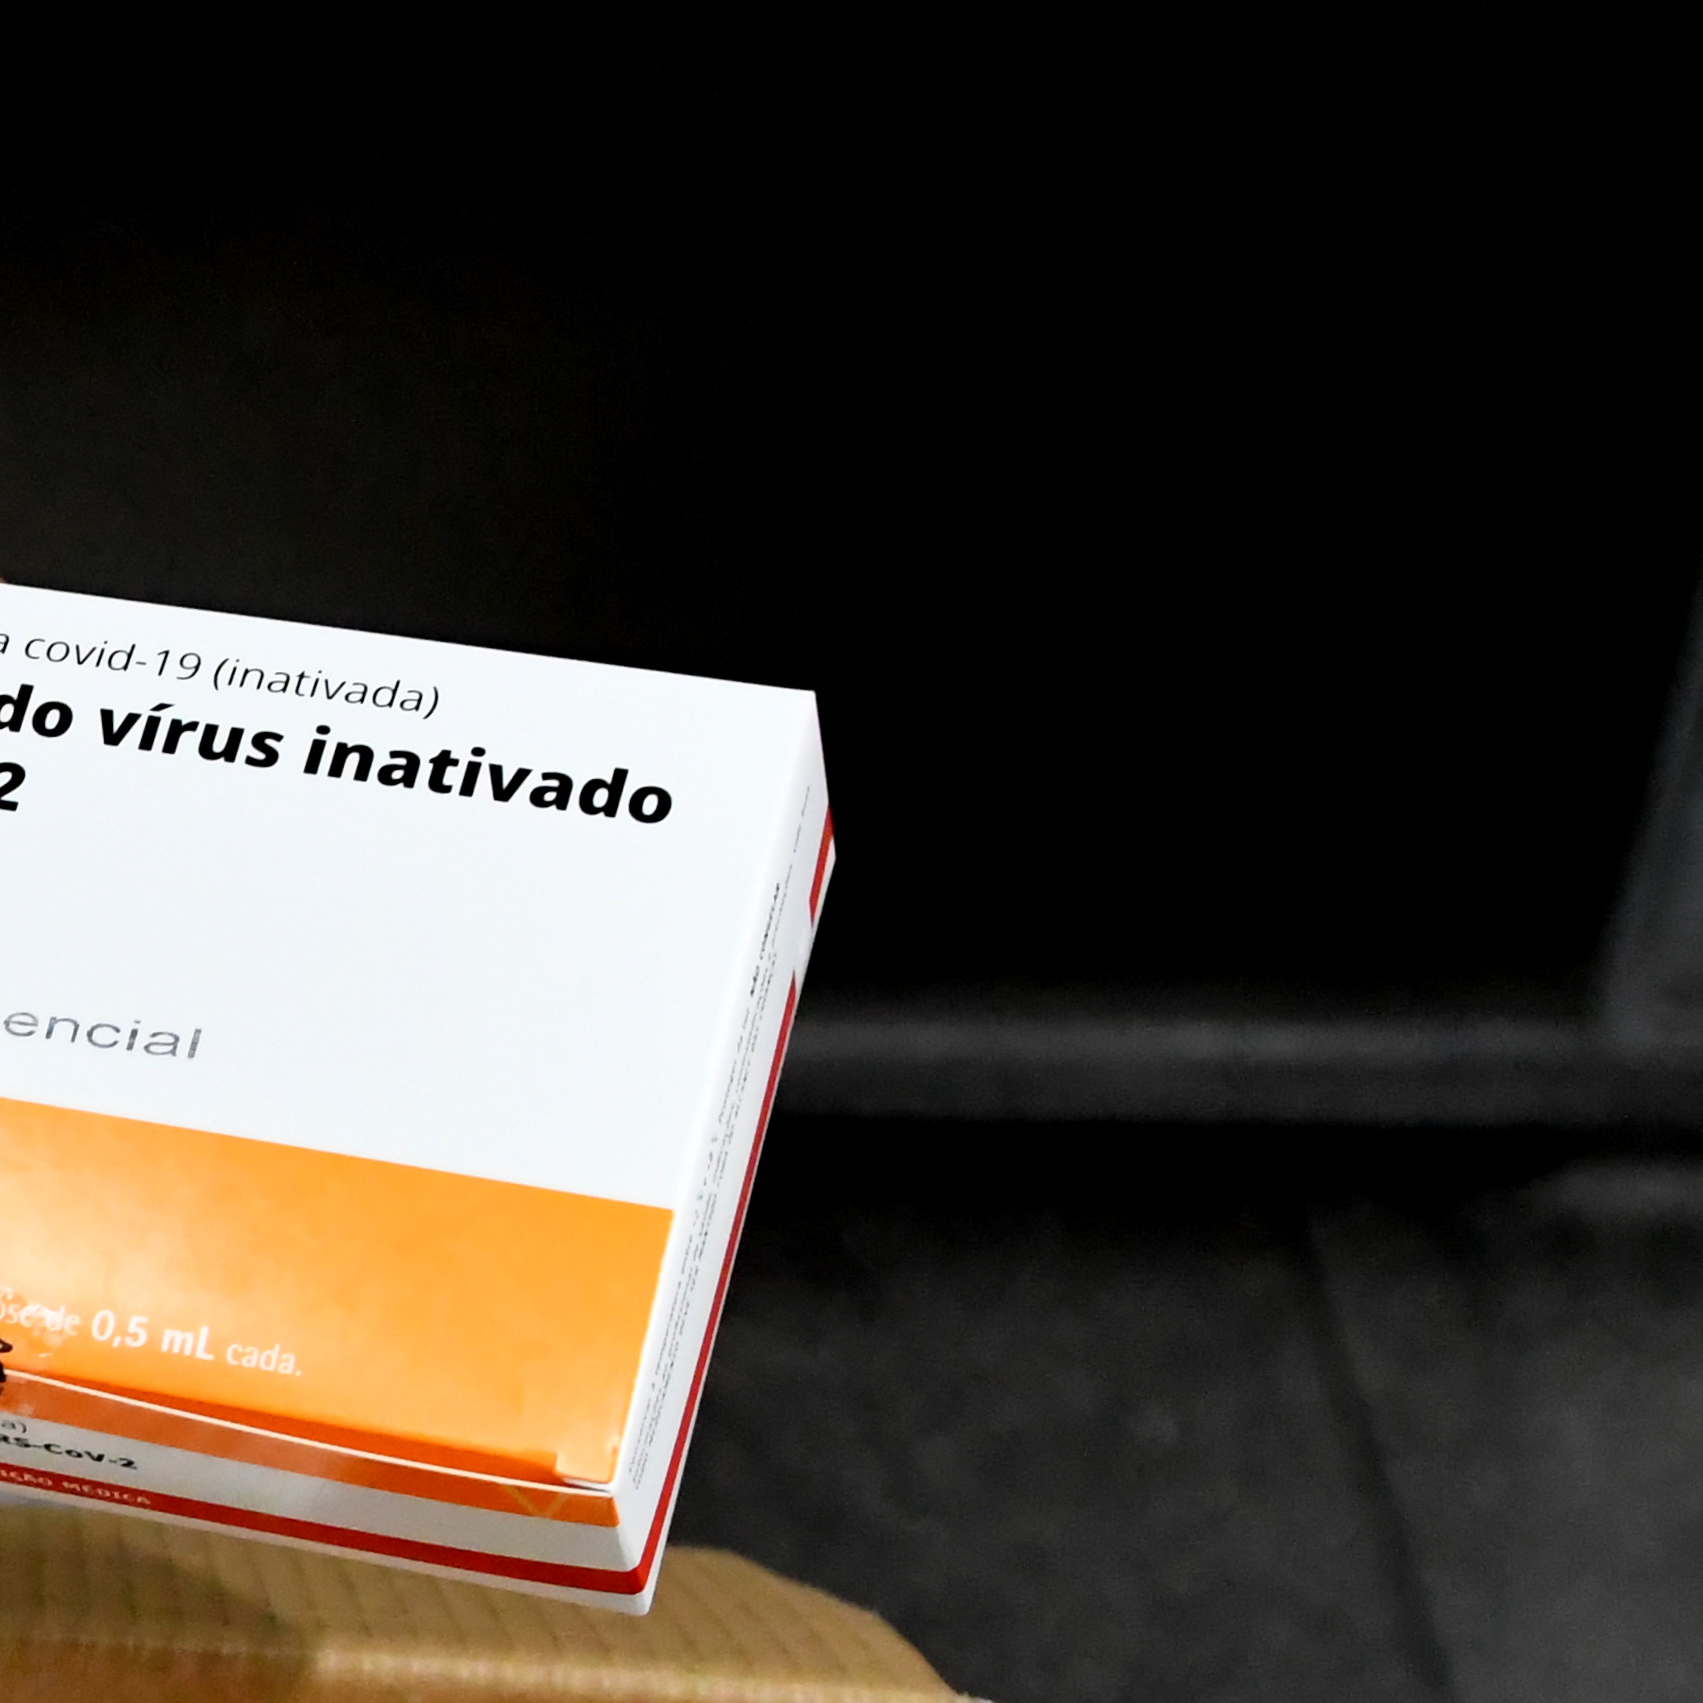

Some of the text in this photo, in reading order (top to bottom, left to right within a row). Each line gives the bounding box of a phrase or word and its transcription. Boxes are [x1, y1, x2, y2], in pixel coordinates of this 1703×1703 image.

[24, 638, 202, 681] covid-19
[213, 657, 439, 720] (inativada)
[99, 702, 285, 769] vírus
[303, 724, 673, 824] inativado
[86, 1309, 149, 1355] 0,5
[161, 1325, 214, 1361] mL
[225, 1342, 304, 1377] cada.
